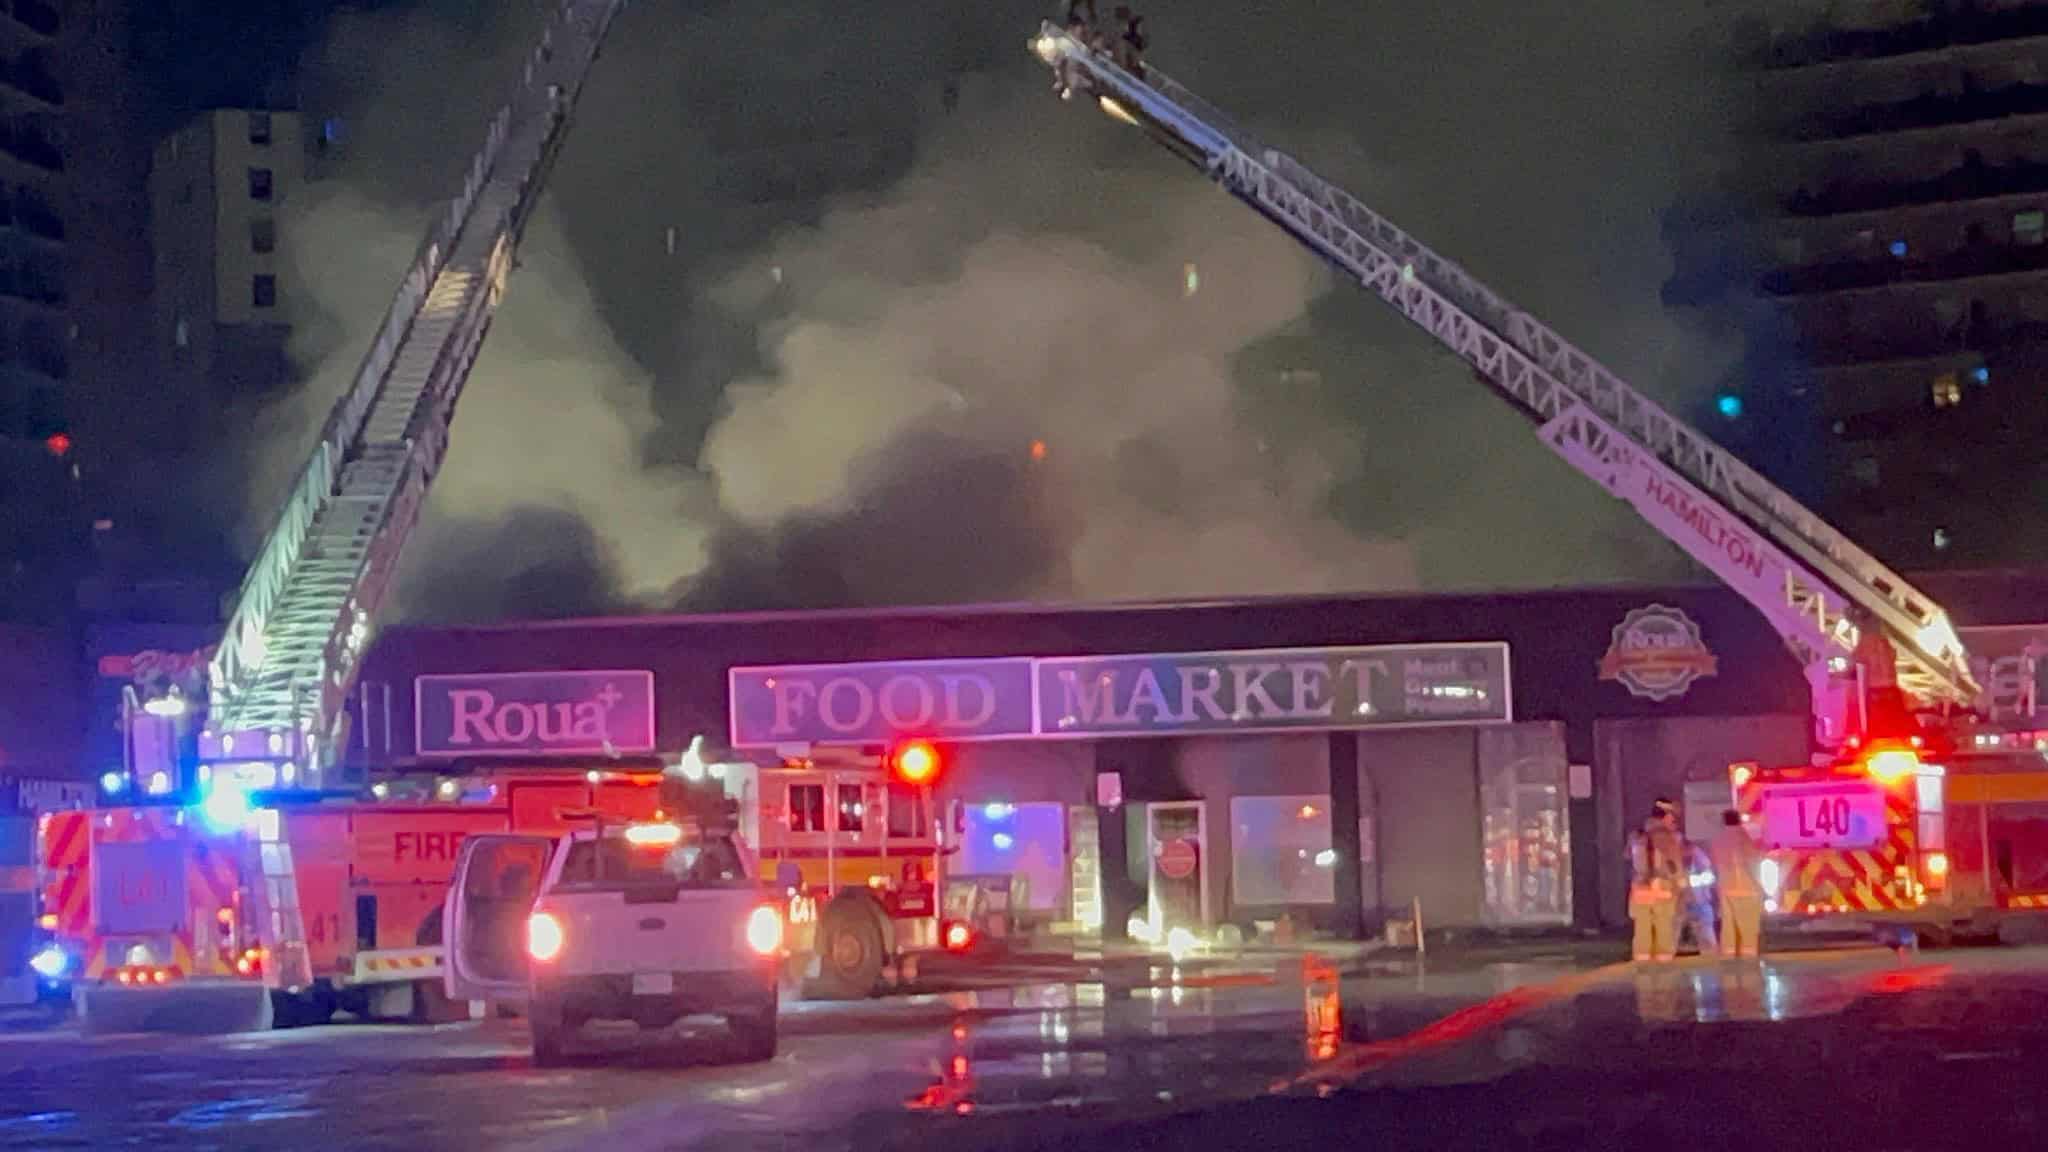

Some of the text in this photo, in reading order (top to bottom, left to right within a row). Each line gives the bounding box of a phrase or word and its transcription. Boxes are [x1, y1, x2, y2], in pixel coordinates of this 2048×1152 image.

[1646, 475, 1764, 578] HAMILTON
[447, 686, 610, 743] Roua
[769, 658, 1390, 735] FOOD MARKET
[1798, 797, 1850, 838] L40
